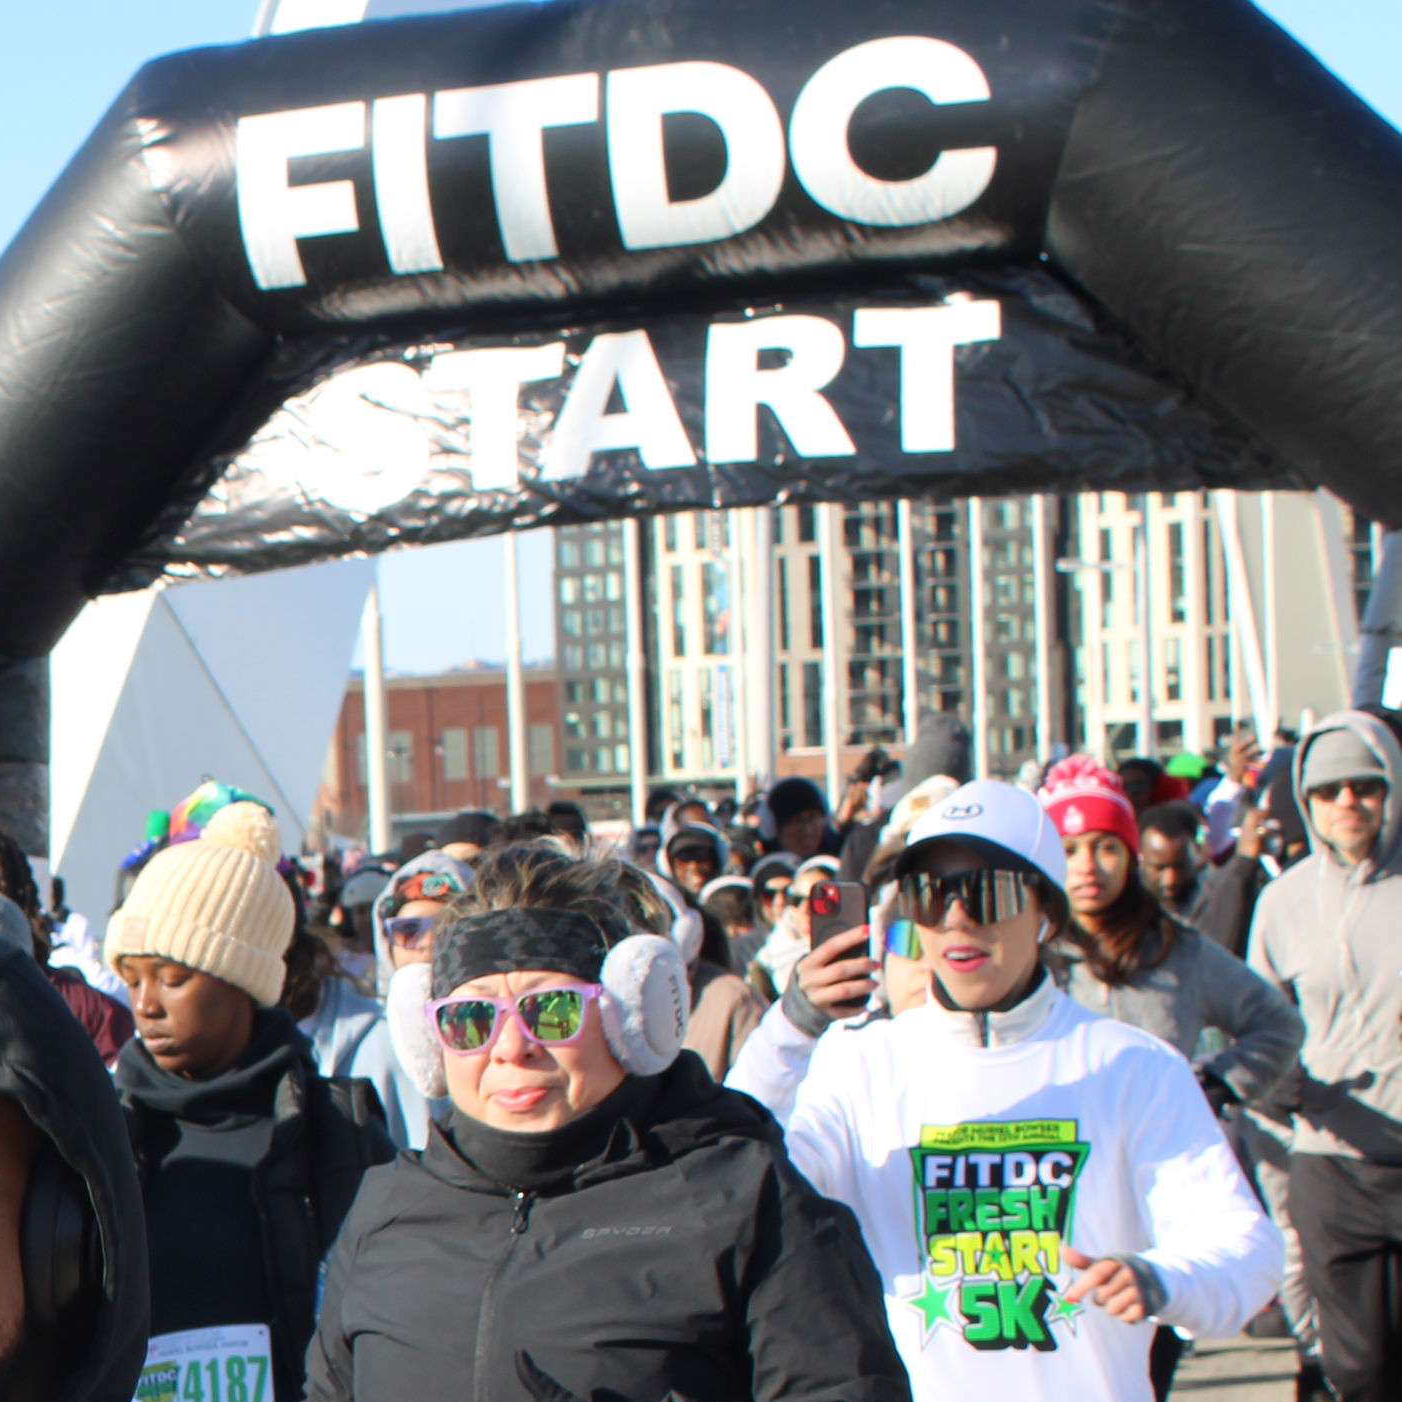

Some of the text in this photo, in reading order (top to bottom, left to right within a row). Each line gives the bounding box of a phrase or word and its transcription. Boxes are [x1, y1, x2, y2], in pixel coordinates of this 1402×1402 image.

[236, 35, 997, 290] FITDC
[300, 299, 1001, 514] START
[923, 1152, 1074, 1189] FITDC
[580, 1226, 672, 1240] SPYDER
[925, 1185, 1062, 1233] FRESH
[928, 1230, 1062, 1280] START
[959, 1275, 1051, 1346] 5K
